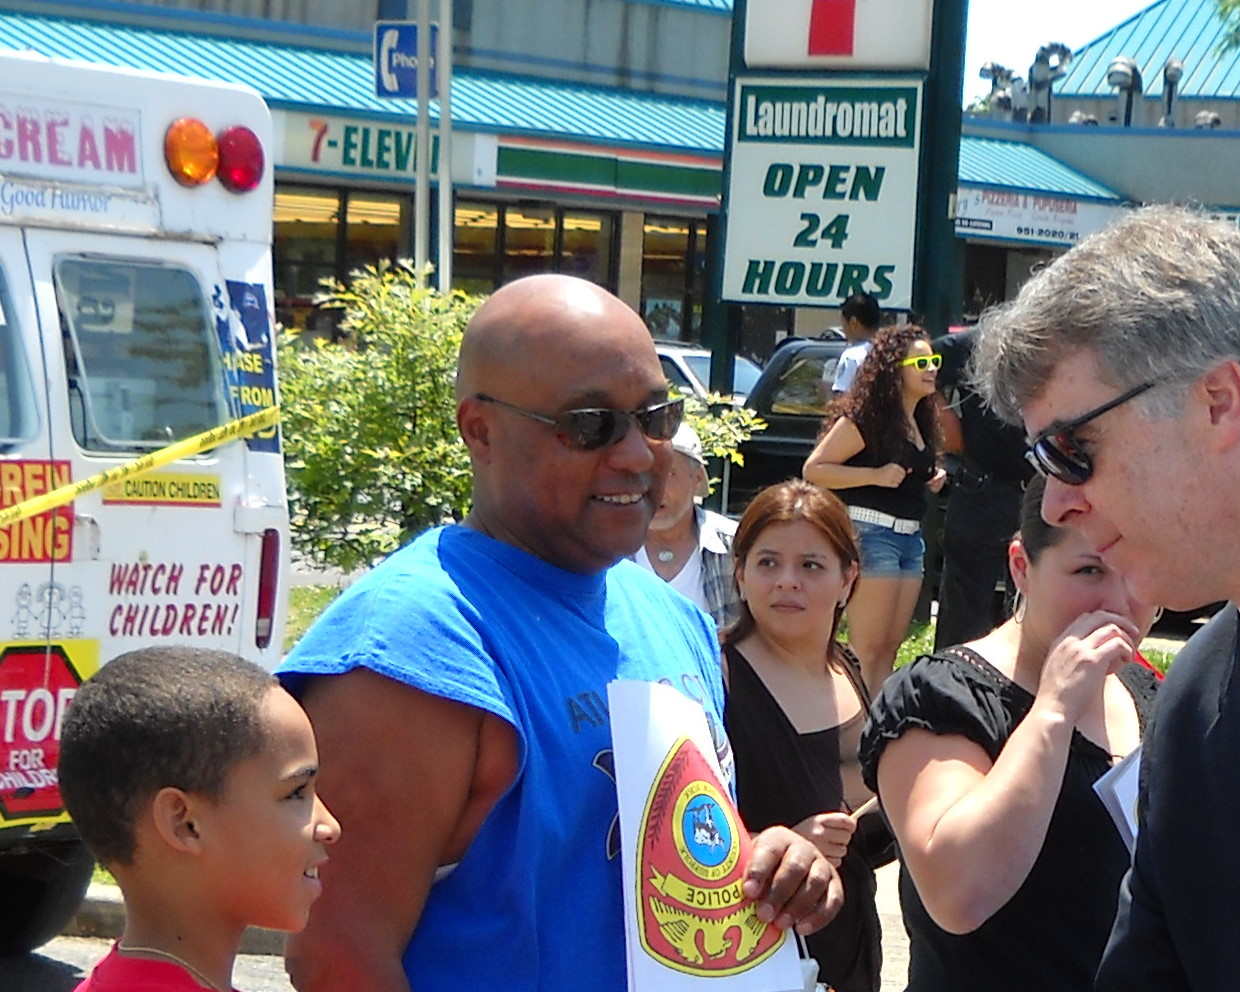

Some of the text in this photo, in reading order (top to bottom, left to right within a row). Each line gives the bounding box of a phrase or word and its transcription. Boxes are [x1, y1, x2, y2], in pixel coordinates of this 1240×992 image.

[392, 53, 434, 69] Pho
[746, 95, 907, 138] Laundromat
[309, 118, 440, 174] 7-ELEV
[1, 181, 45, 215] Good
[762, 163, 886, 201] OPEN
[793, 212, 850, 249] 24
[742, 260, 896, 300] HOURS
[125, 481, 220, 499] CAUTION CHILDREN
[0, 516, 69, 560] ING
[109, 563, 242, 596] WATCH FOR
[109, 603, 239, 637] CHILDREN!
[9, 749, 45, 771] FOR
[686, 884, 742, 907] POLICE
